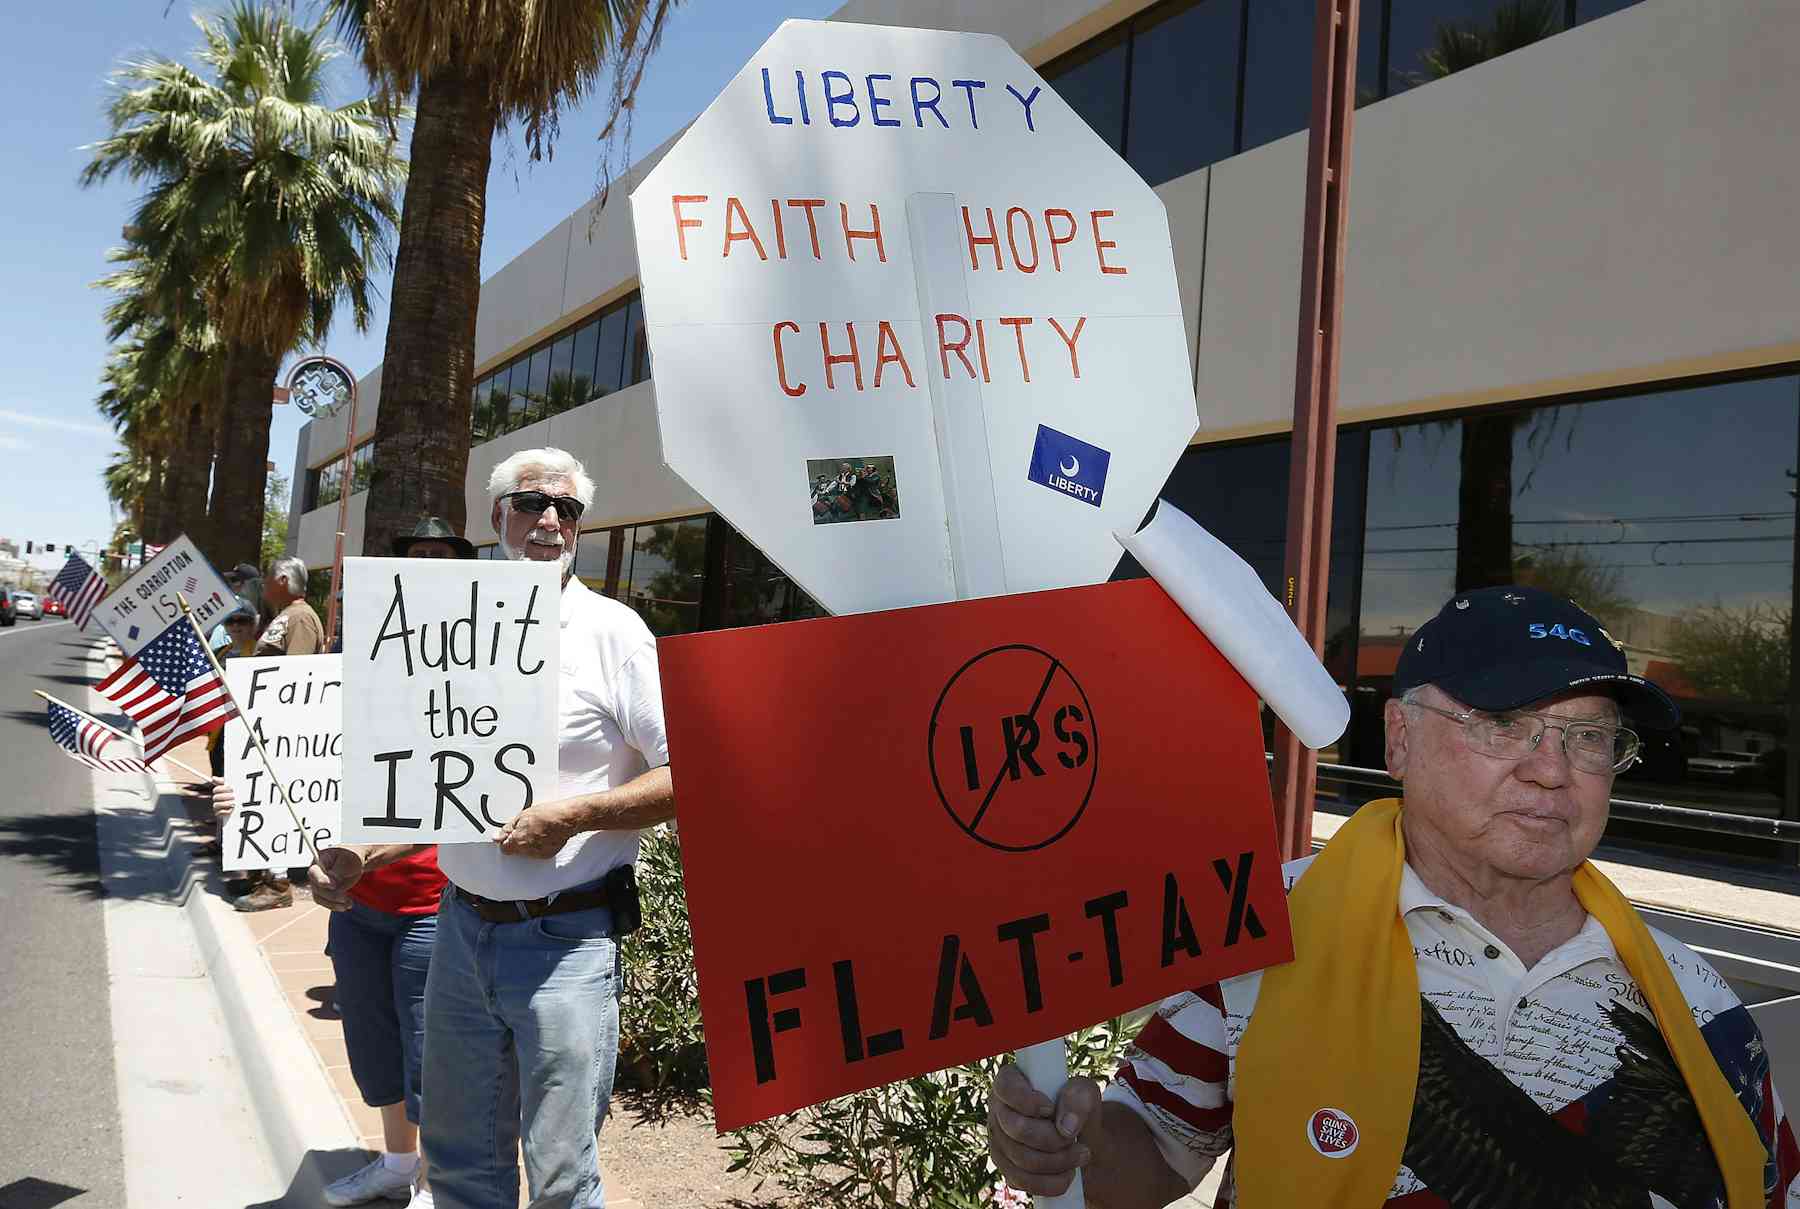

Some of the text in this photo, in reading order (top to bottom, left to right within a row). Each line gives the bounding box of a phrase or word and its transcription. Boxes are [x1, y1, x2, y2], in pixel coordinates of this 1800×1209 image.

[761, 67, 1042, 132] LIBERTY
[672, 194, 1129, 275] FAITH HOPE
[772, 313, 1087, 398] CHARITY
[1048, 473, 1098, 501] LIBERTY
[113, 550, 193, 619] THE CORRUPTION
[152, 594, 178, 625] IS
[369, 572, 546, 678] Audit
[1529, 623, 1592, 646] 54G
[248, 665, 342, 710] Fair
[424, 680, 499, 739] the
[958, 704, 1089, 792] IRS
[362, 742, 536, 834] IRS
[237, 810, 332, 862] Rate
[1319, 1133, 1348, 1149] LIVES
[1320, 1125, 1346, 1139] SAVE
[1322, 1116, 1348, 1131] GUNS
